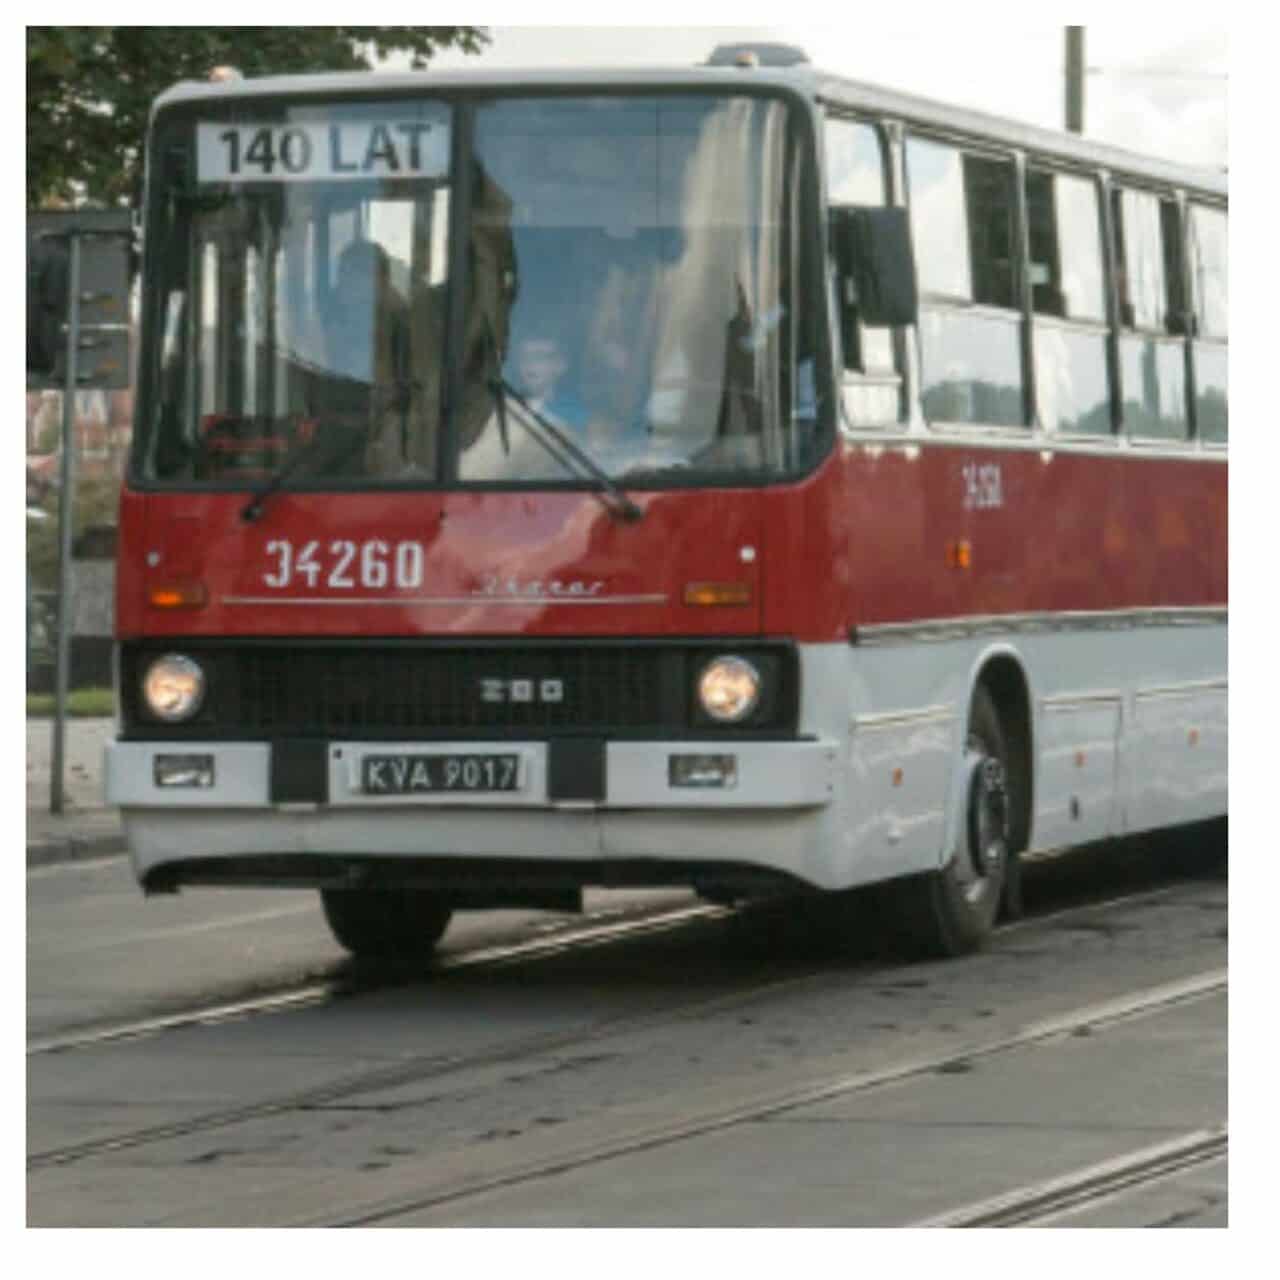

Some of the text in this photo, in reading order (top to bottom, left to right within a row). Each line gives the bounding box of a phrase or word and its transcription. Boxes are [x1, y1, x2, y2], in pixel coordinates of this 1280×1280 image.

[218, 122, 432, 174] 140 LAT
[264, 539, 424, 588] 34260
[368, 757, 517, 788] KVA 9017
